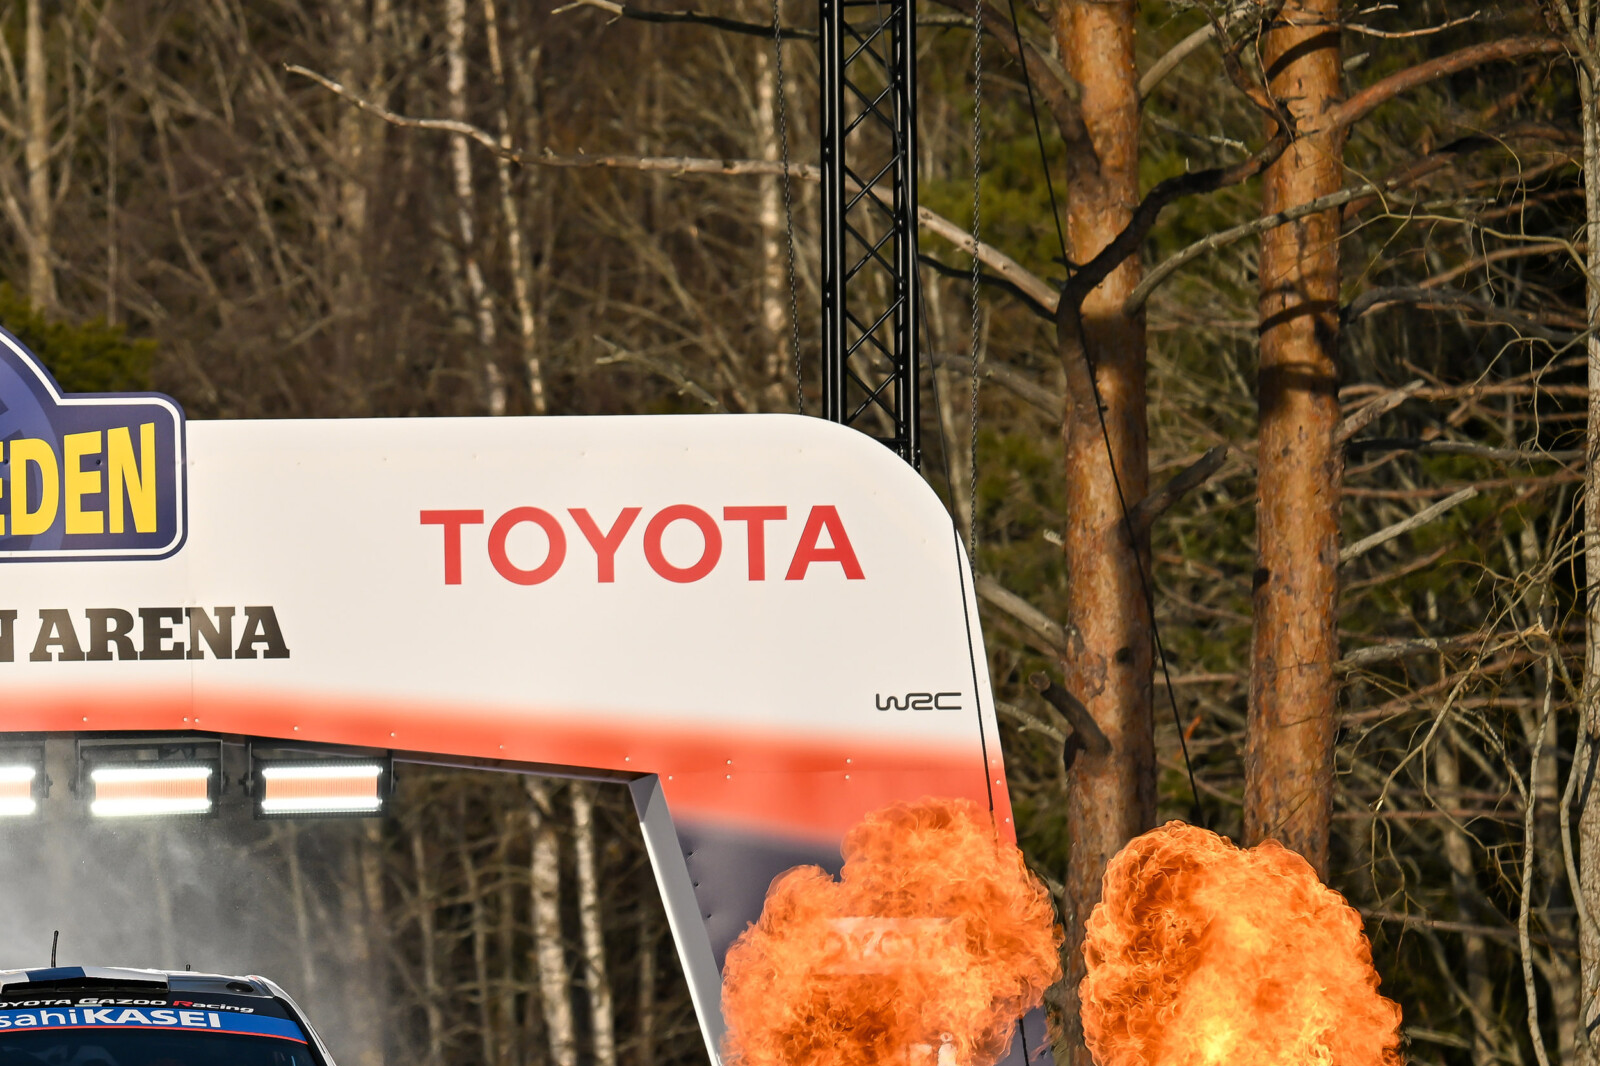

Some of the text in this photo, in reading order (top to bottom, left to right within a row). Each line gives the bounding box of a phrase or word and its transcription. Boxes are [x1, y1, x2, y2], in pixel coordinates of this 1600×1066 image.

[420, 504, 866, 586] TOYOTA
[29, 605, 291, 661] ARENA
[77, 997, 167, 1007] GAZOO
[172, 1000, 255, 1013] Racing
